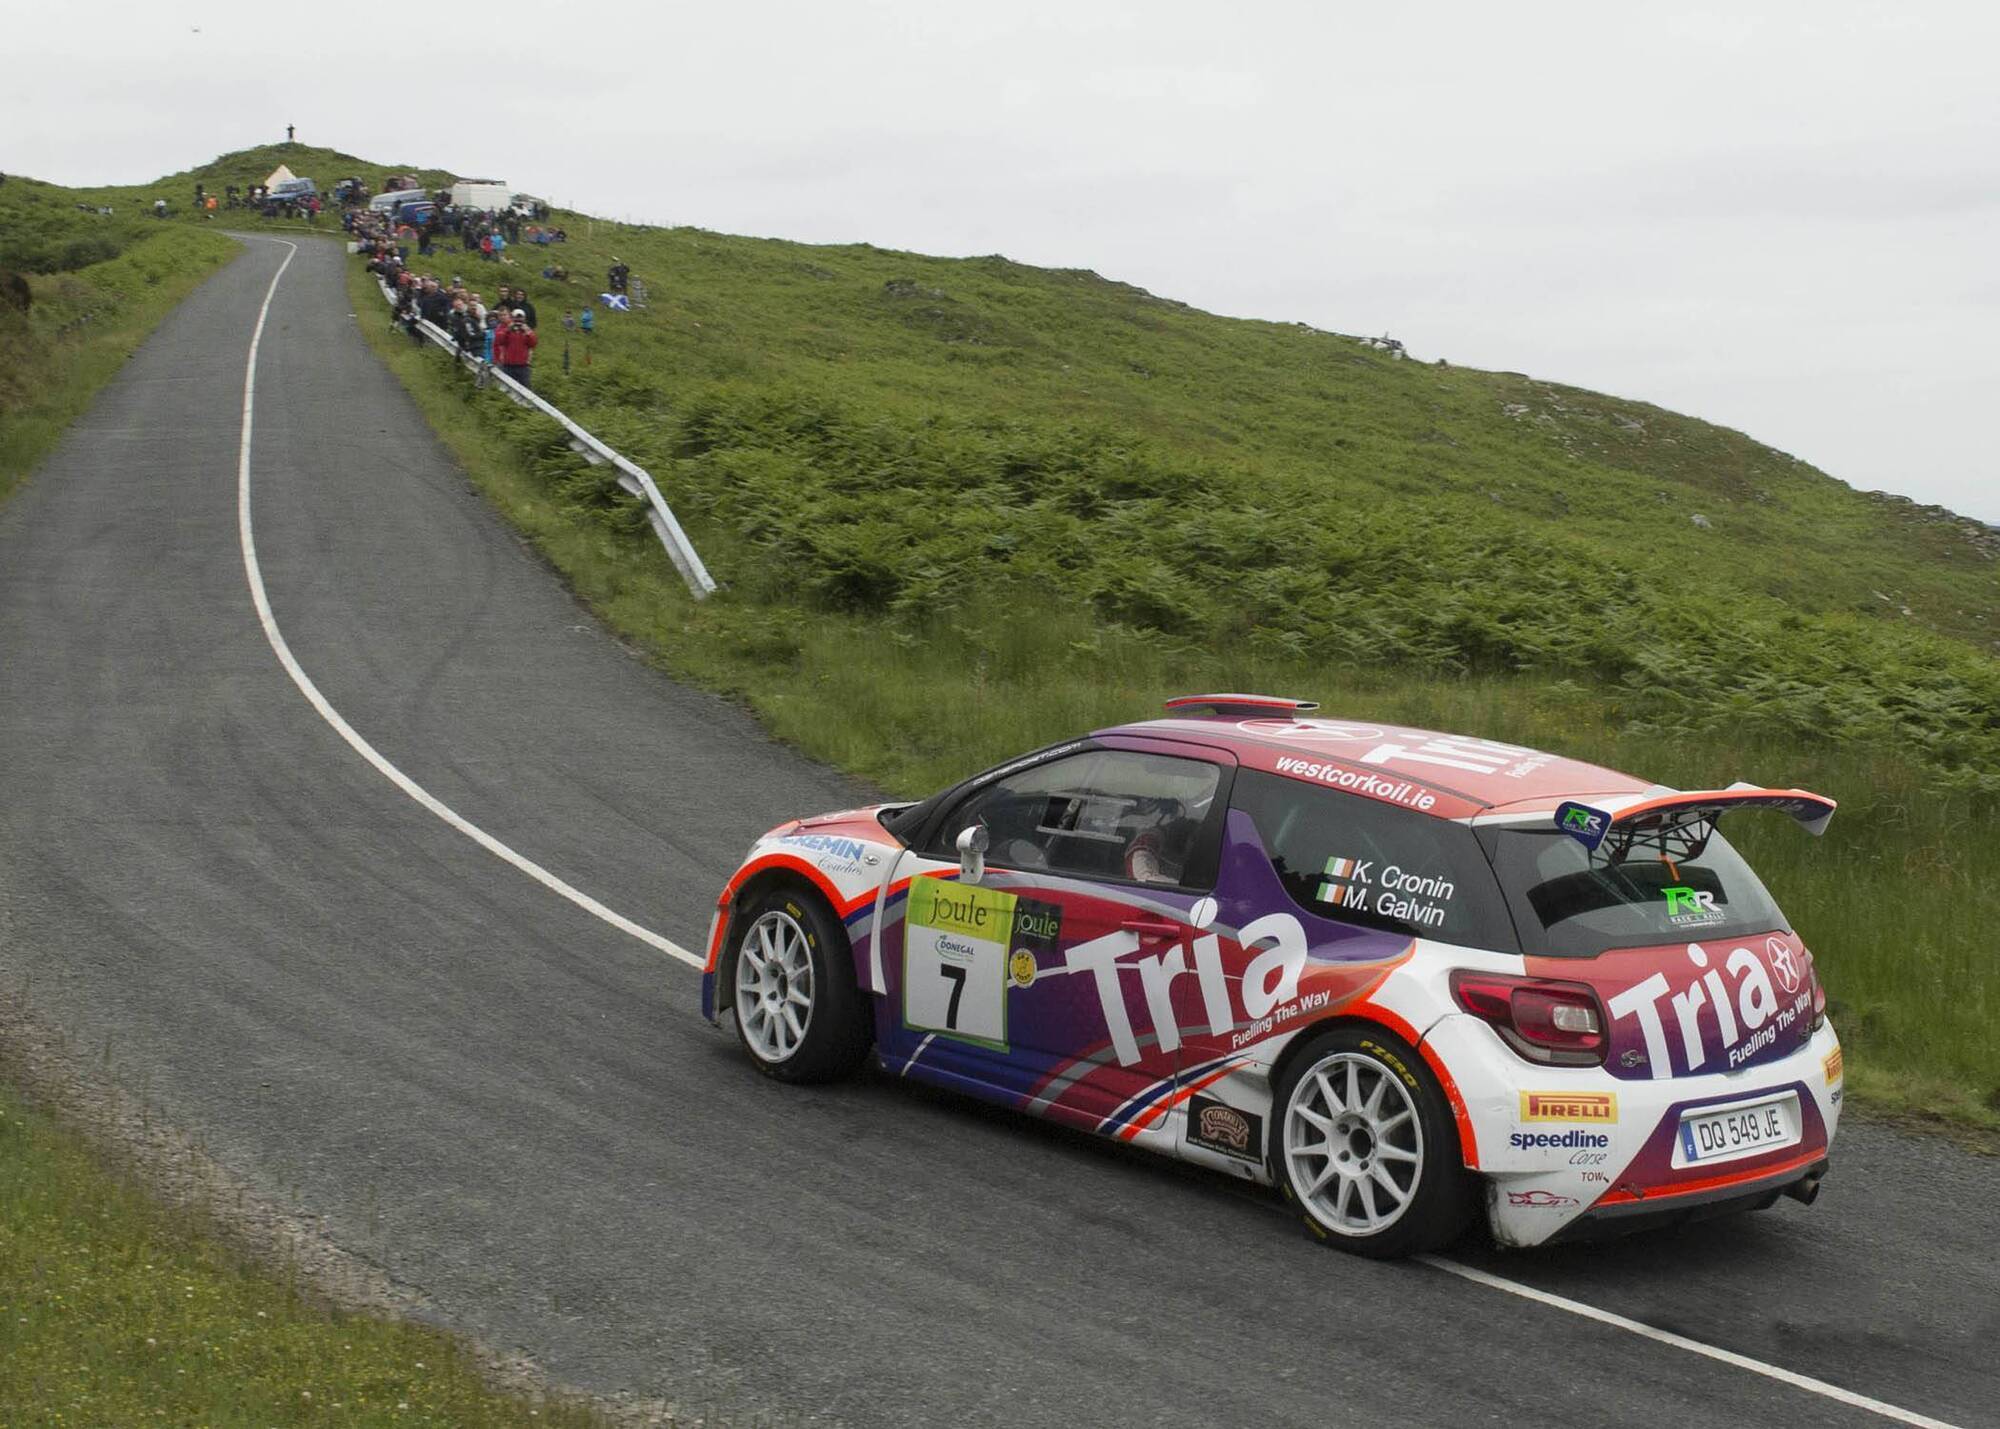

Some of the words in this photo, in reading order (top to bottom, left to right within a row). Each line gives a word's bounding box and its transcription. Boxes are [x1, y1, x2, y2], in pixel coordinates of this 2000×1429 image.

[1275, 756, 1436, 810] westcorkoil.ie
[1351, 859, 1374, 884] K.
[1381, 865, 1454, 900] Cronin
[929, 889, 987, 926] joule
[1014, 908, 1059, 937] joule
[1342, 885, 1369, 912] M.
[1377, 892, 1445, 926] Galvin
[940, 940, 975, 956] DONEGAL
[941, 963, 966, 1030] 7
[1065, 897, 1307, 1067] Tria
[1232, 1017, 1272, 1049] Fuelling
[1275, 1003, 1298, 1024] The
[1300, 990, 1331, 1011] Way
[1607, 943, 1778, 1080] Tria
[1728, 1025, 1776, 1068] Fuelling
[1776, 1008, 1795, 1032] The
[1795, 988, 1812, 1014] Way
[1529, 1095, 1610, 1118] PIRELLI
[1510, 1130, 1609, 1150] speedline
[1698, 1121, 1727, 1151] DQ
[1728, 1114, 1760, 1145] 549
[1764, 1109, 1781, 1138] JE
[1568, 1149, 1607, 1165] Corse
[1582, 1172, 1604, 1182] TOW
